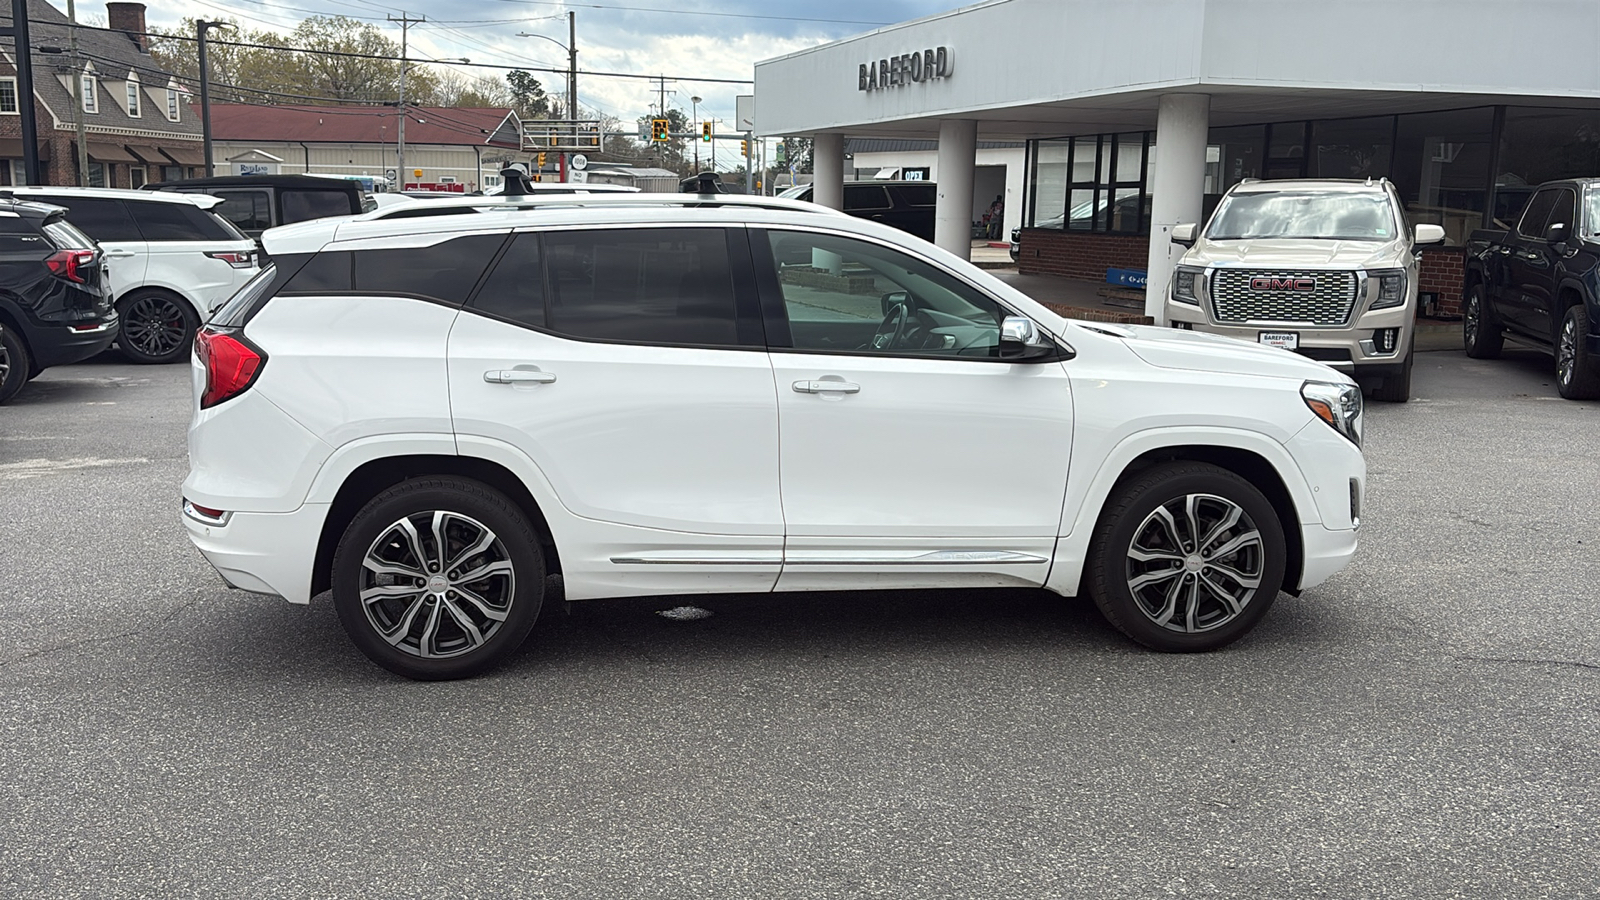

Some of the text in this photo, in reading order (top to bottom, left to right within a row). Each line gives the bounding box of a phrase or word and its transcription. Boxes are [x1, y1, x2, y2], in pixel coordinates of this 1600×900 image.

[858, 46, 951, 91] BAREFORD
[905, 171, 923, 181] OPEN
[1252, 278, 1314, 291] GMC
